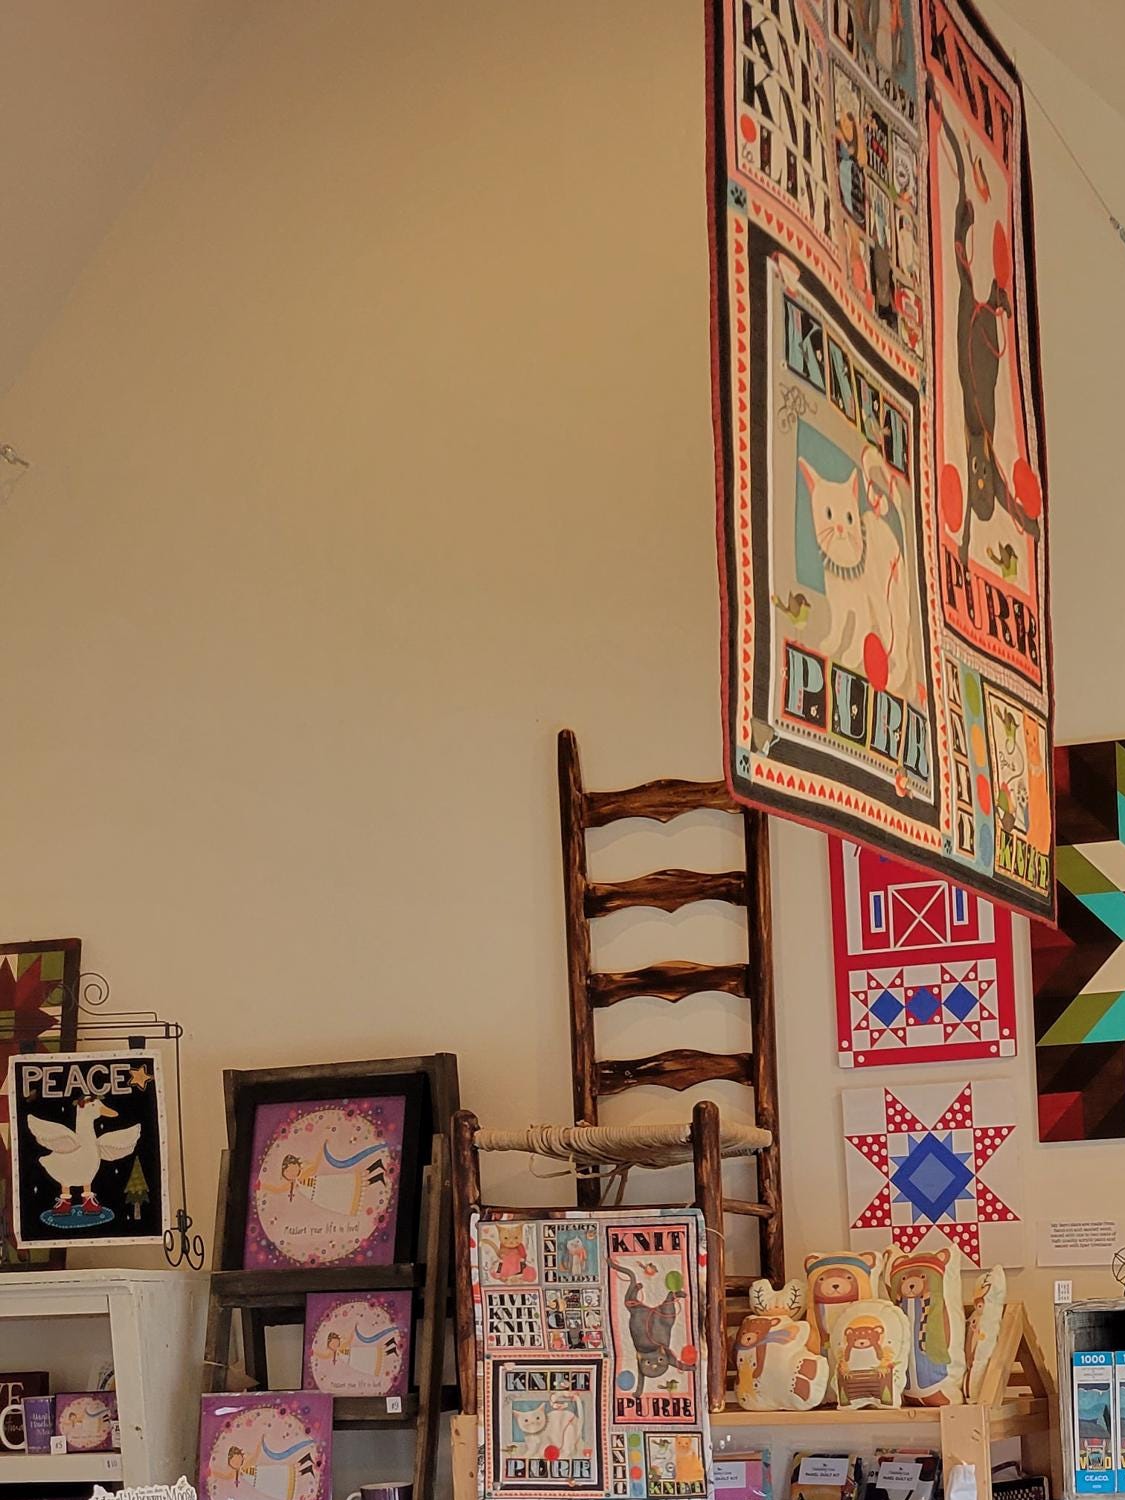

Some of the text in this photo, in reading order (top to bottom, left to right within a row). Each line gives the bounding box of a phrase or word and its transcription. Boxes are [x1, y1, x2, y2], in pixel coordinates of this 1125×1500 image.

[944, 563, 1038, 668] PURR
[785, 647, 929, 780] PURR
[22, 1064, 131, 1097] PEACE
[612, 1231, 685, 1252] KNIT
[488, 1294, 537, 1306] LIVE
[489, 1307, 538, 1320] KNIT
[489, 1321, 539, 1333] KNIT
[1081, 1354, 1105, 1364] 1000
[617, 1397, 695, 1418] PURR
[506, 1459, 593, 1478] PURR
